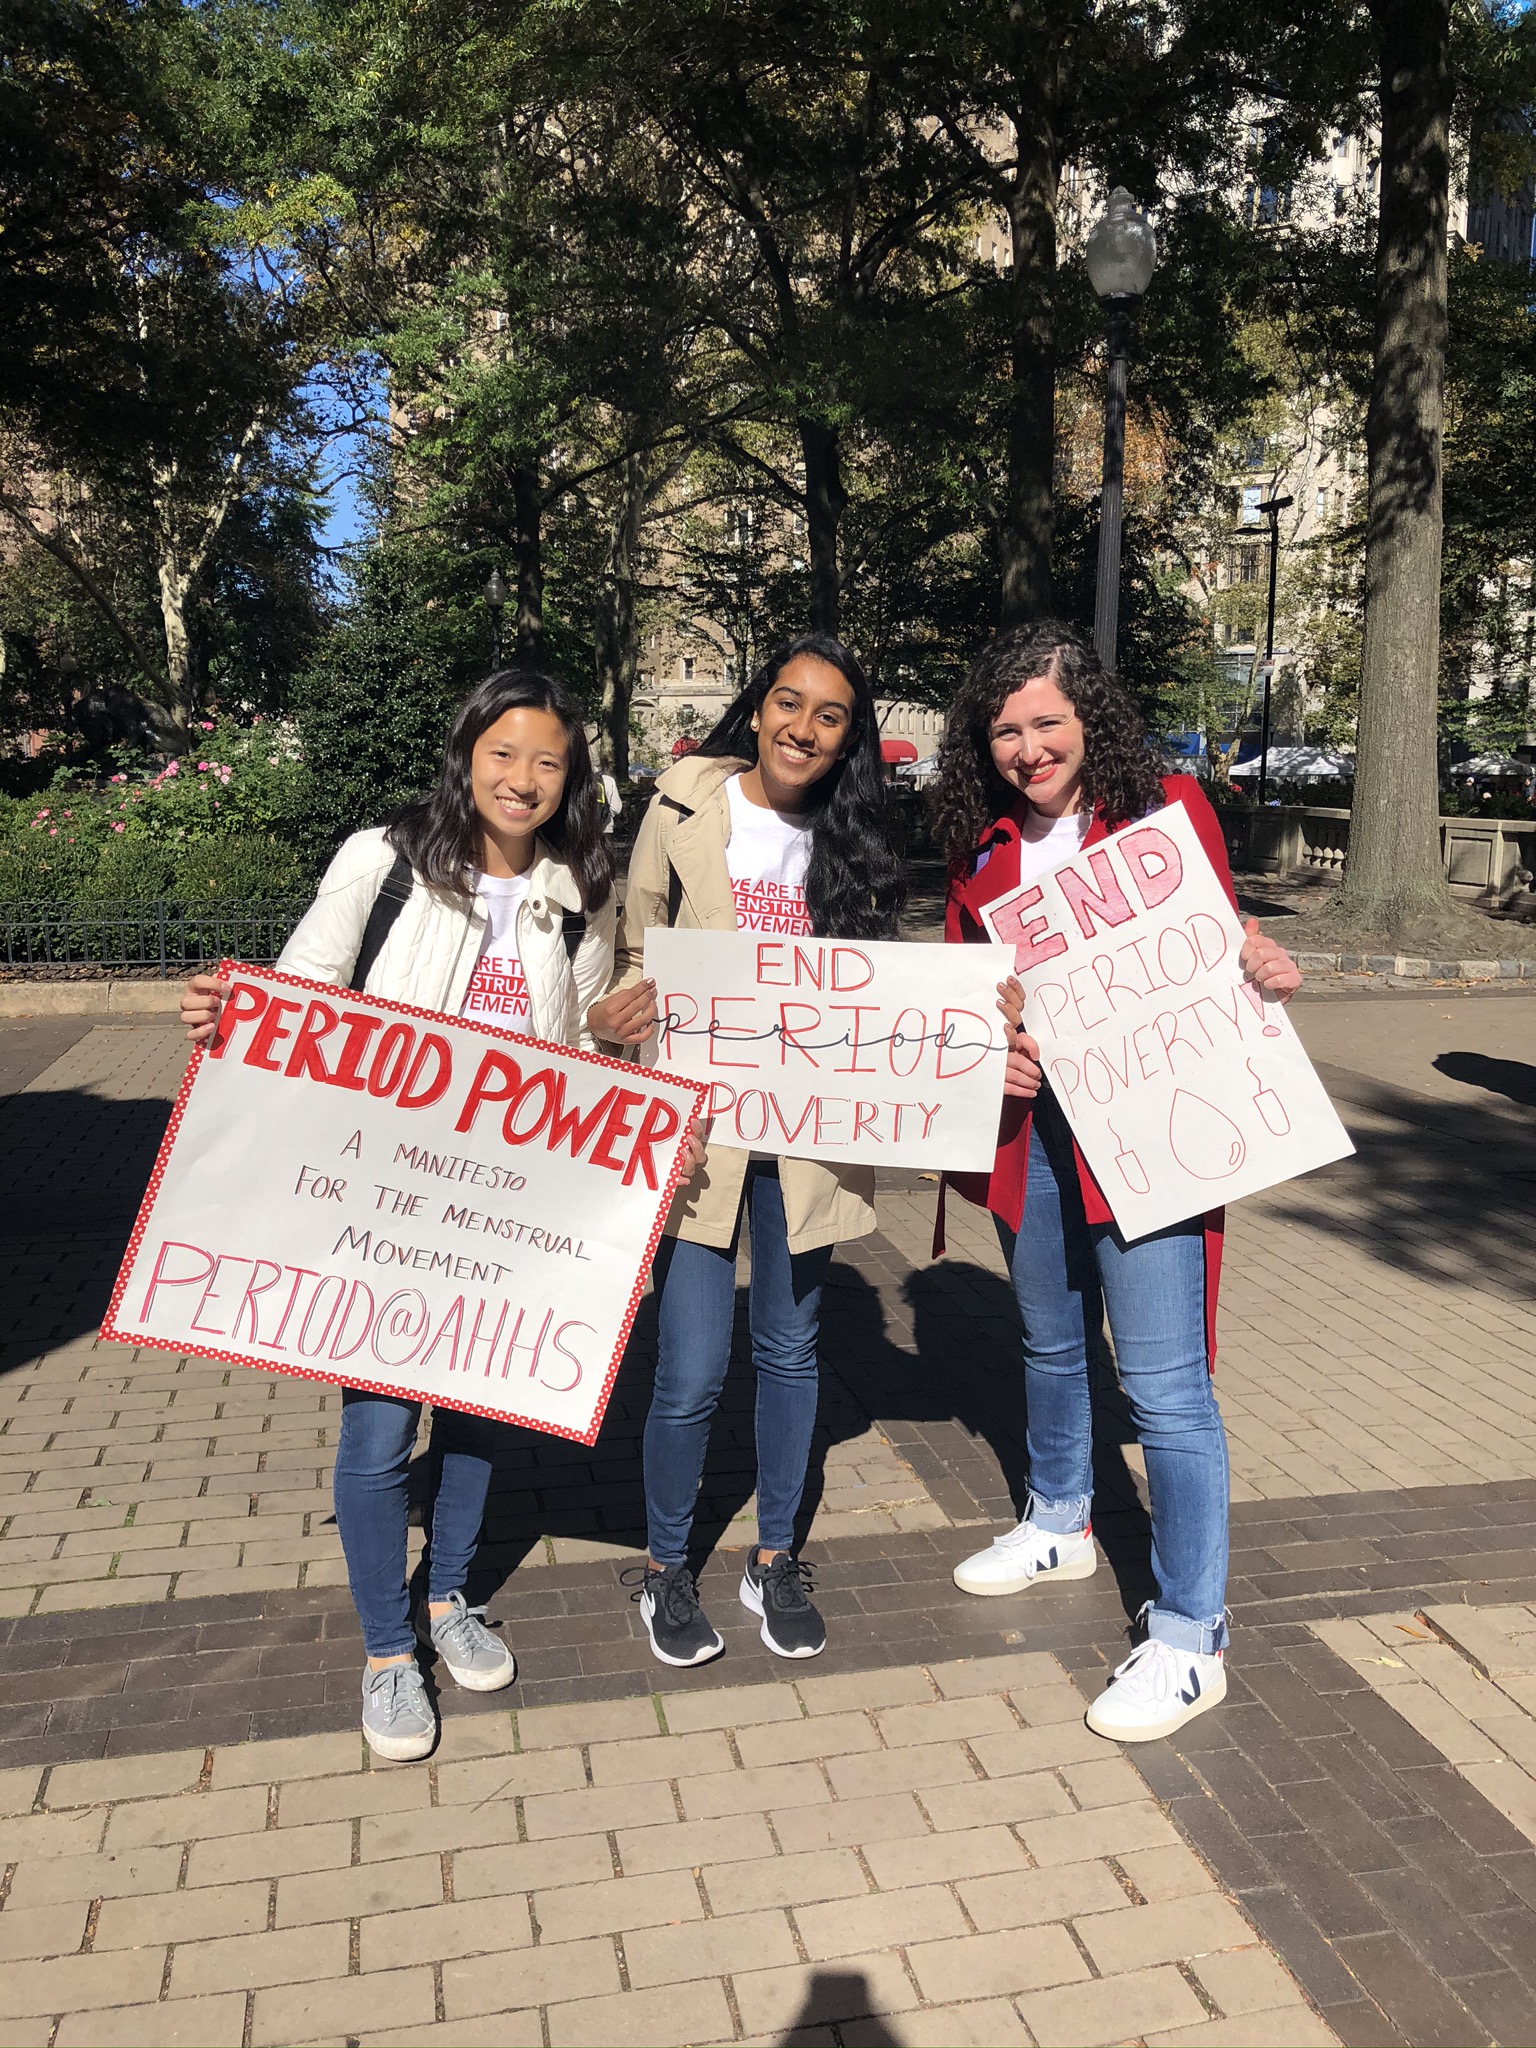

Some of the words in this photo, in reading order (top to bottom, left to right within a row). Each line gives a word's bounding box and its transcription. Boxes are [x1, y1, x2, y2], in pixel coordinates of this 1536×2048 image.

[734, 895, 810, 917] ENSTRU
[753, 880, 788, 898] ARE
[989, 826, 1183, 975] END
[756, 942, 874, 991] END
[1034, 913, 1227, 1039] PERIOD
[652, 1012, 1008, 1051] period
[664, 993, 992, 1079] PERIOD
[1050, 979, 1281, 1119] POVERTY!
[209, 982, 453, 1111] PERIOD
[454, 1048, 682, 1190] POWER
[705, 1080, 943, 1146] POVERTY
[340, 1129, 361, 1159] A
[393, 1143, 527, 1191] MANIFESTO
[295, 1165, 347, 1202] FOR
[374, 1184, 428, 1218] THE
[442, 1204, 591, 1261] MENSTRUAL
[332, 1225, 513, 1284] MOVEMENT
[139, 1241, 598, 1392] PERIOD@AHHS
